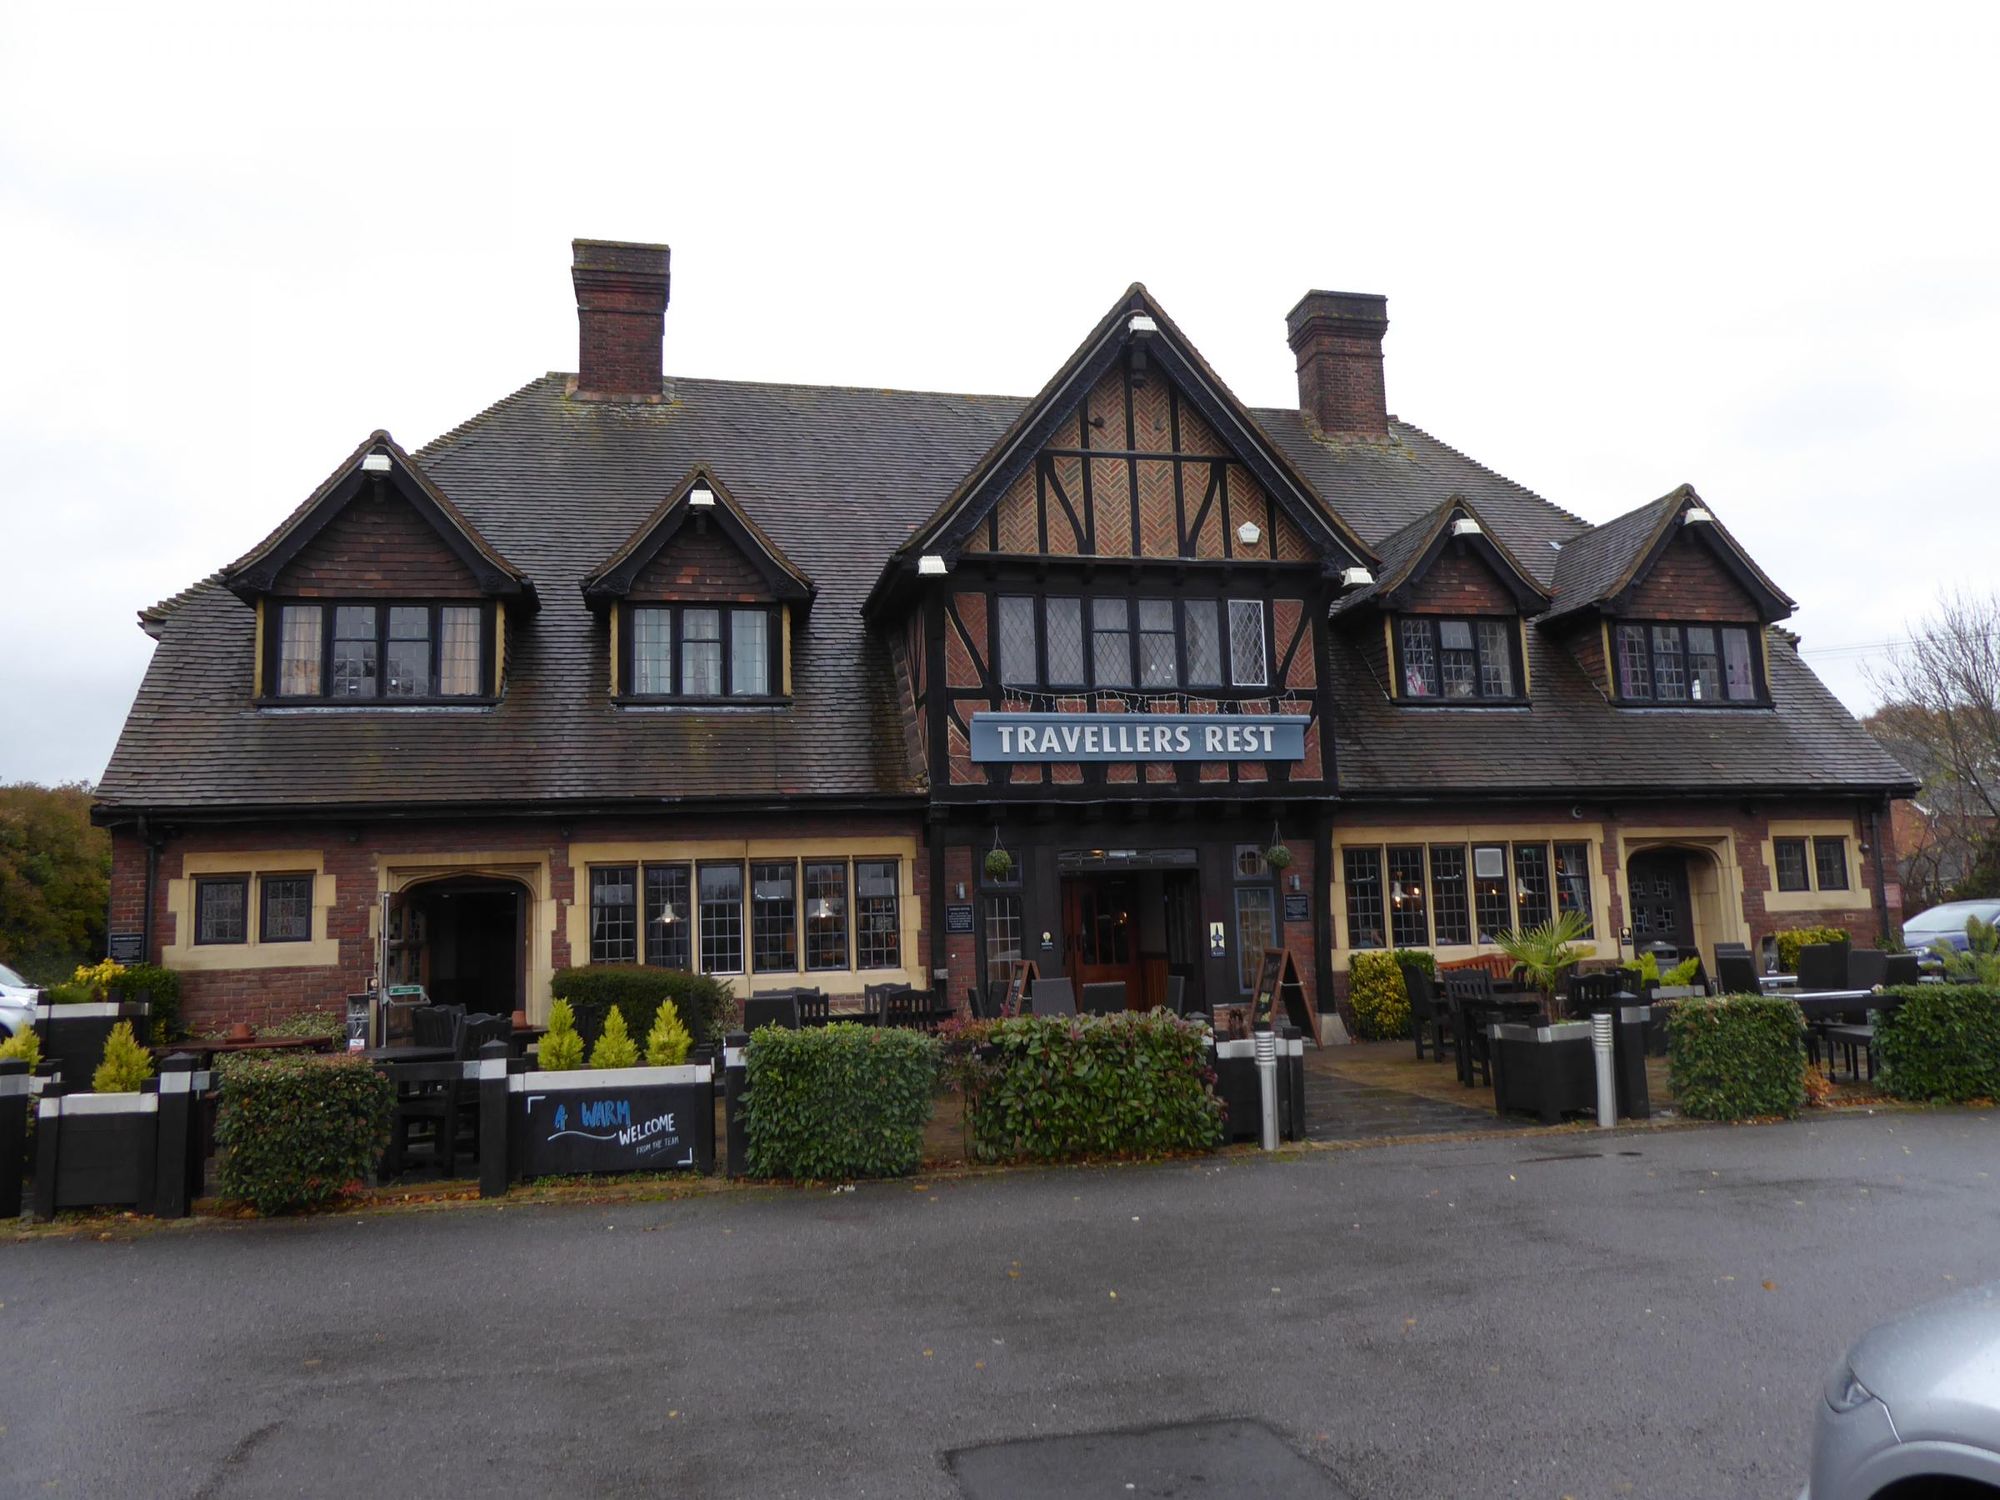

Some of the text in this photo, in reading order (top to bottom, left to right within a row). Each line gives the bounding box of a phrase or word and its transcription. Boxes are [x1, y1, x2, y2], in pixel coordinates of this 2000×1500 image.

[998, 725, 1275, 753] TRAVELLERS REST
[554, 1099, 630, 1130] A WARM
[618, 1112, 676, 1146] WELCOME
[636, 1136, 679, 1155] FROM THE TEAM
